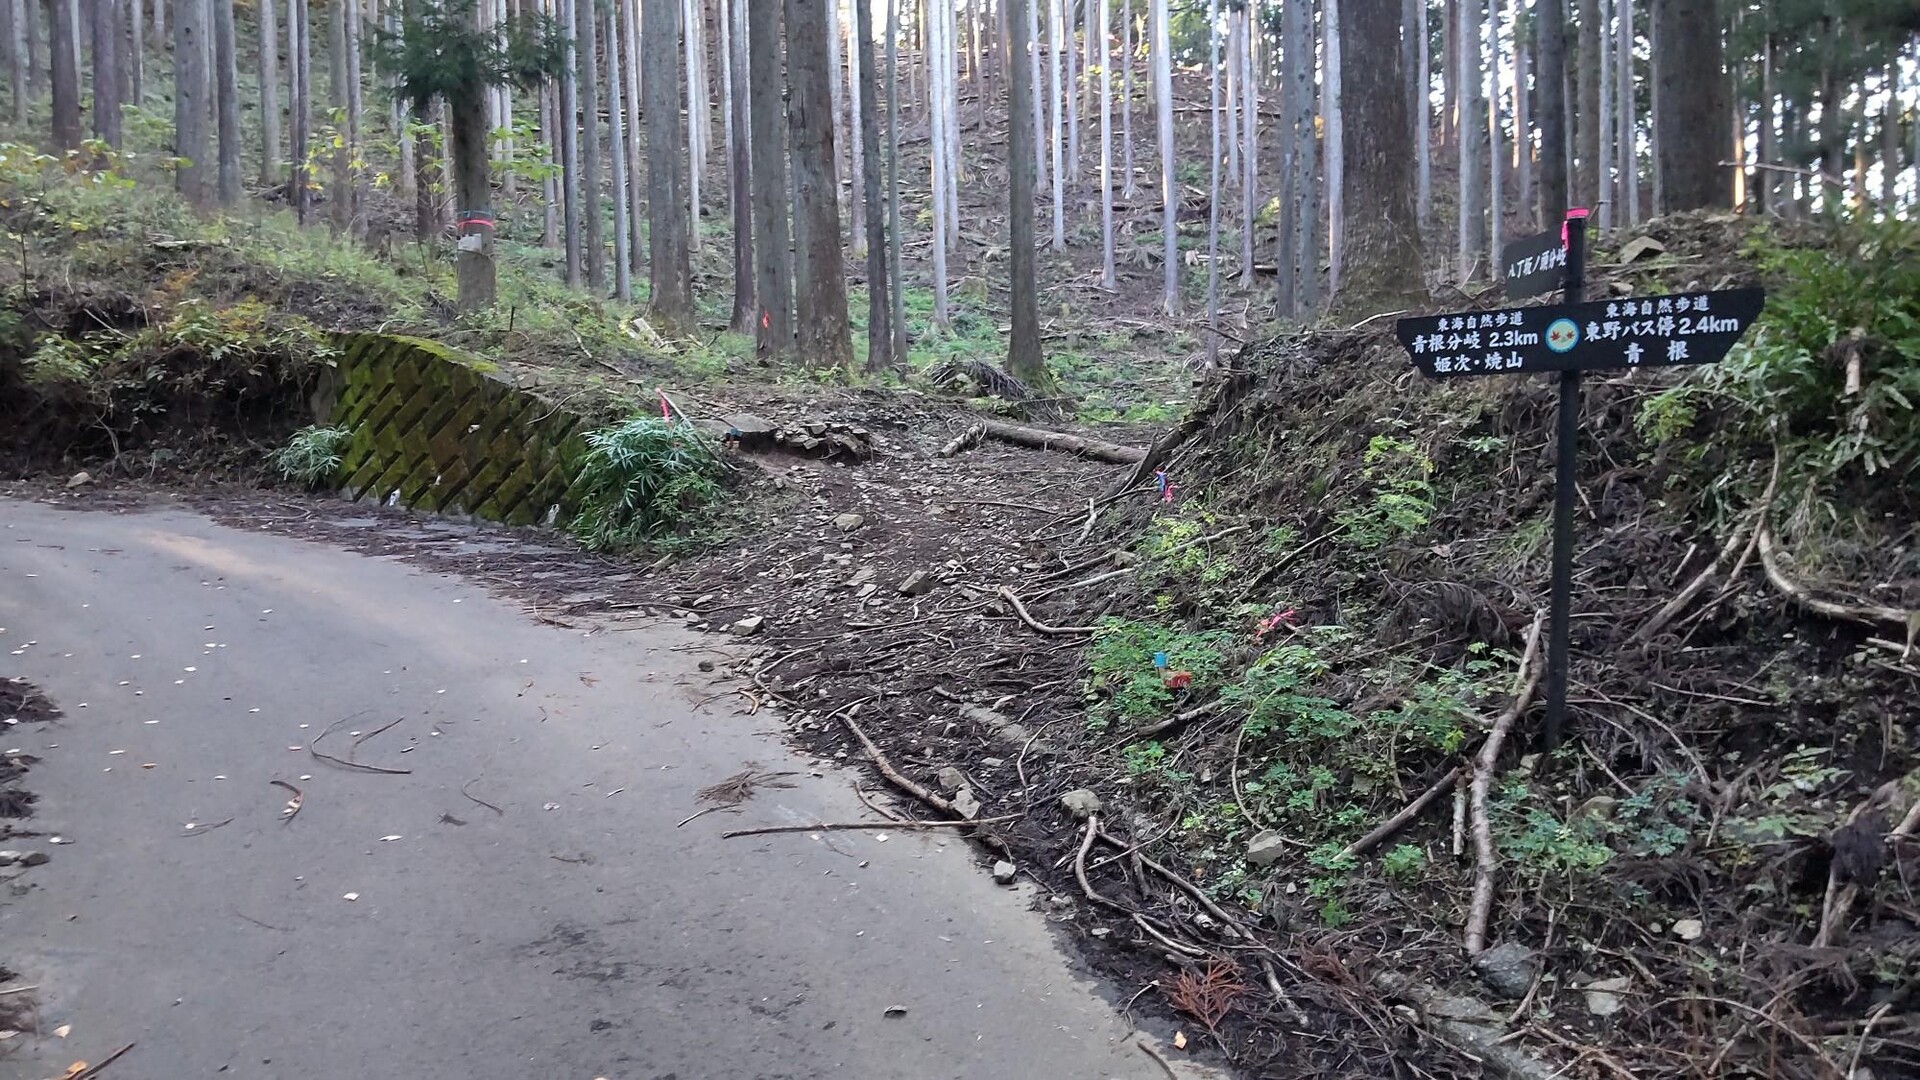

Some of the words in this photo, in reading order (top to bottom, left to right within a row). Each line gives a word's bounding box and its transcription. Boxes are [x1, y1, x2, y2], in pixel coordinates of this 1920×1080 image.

[1605, 295, 1710, 319] 東海自然歩道
[1437, 311, 1524, 332] 東海自然歩道
[1411, 332, 1482, 354] 青根分岐
[1488, 330, 1539, 348] 2.3km
